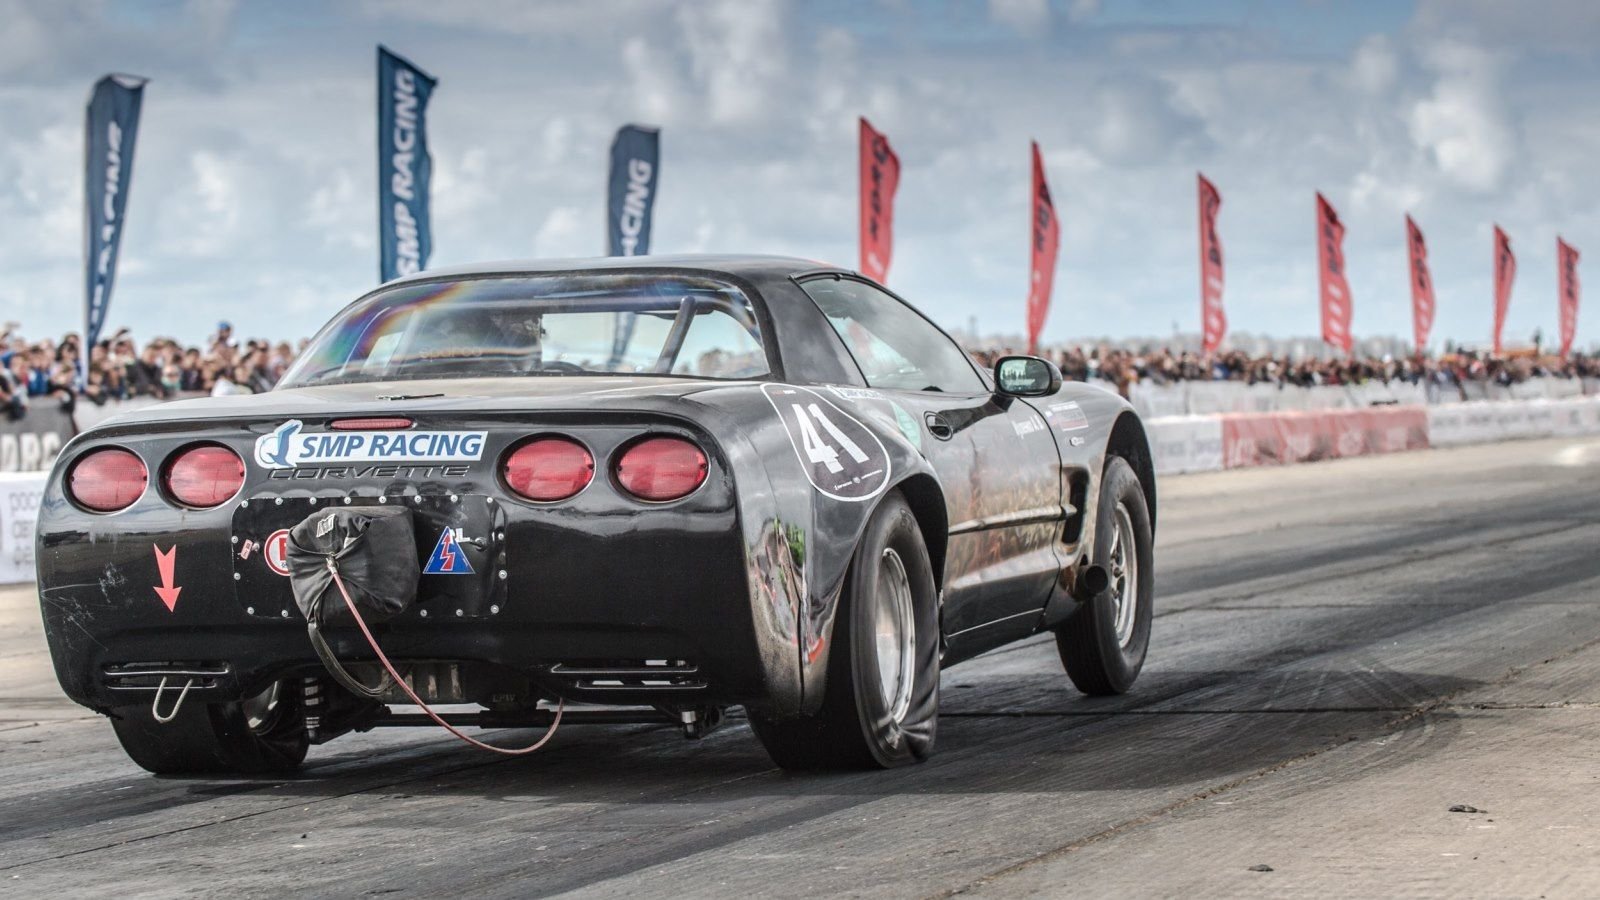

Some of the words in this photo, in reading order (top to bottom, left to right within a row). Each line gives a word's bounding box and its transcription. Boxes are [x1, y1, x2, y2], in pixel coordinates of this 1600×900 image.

[392, 69, 418, 199] RACING
[394, 201, 421, 279] SMP
[267, 464, 470, 480] CORVETTE
[299, 434, 364, 458] SMP
[367, 433, 482, 457] RACING
[791, 403, 870, 474] 41
